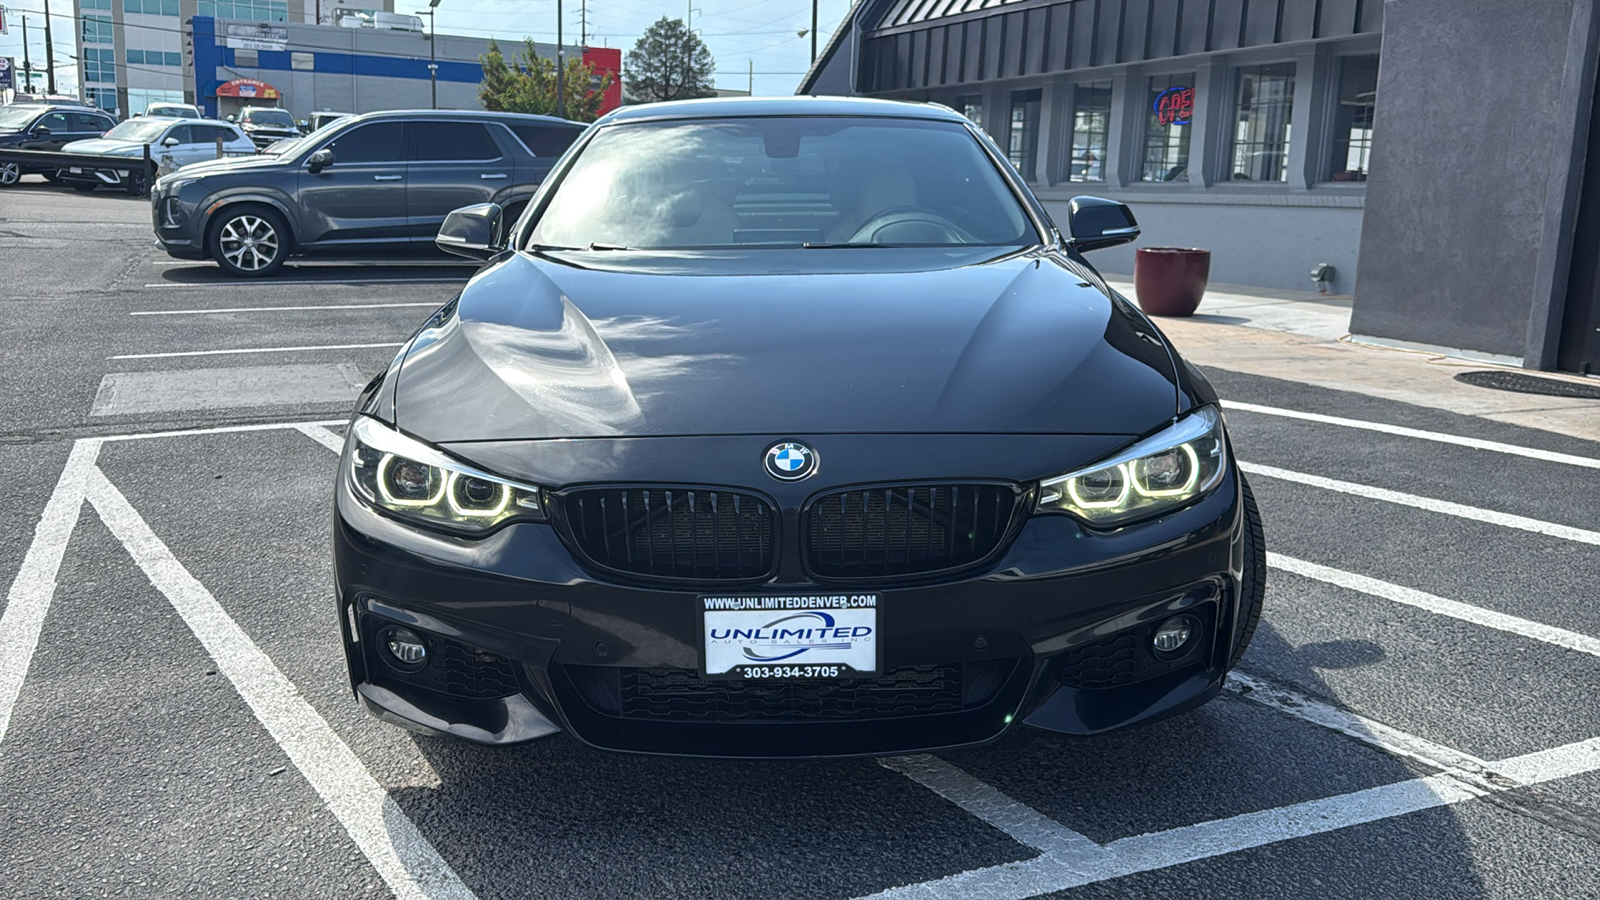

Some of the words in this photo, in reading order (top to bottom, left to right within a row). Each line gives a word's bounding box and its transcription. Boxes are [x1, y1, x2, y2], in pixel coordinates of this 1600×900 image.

[231, 79, 265, 88] ENTRANCE
[1158, 88, 1195, 126] OPE
[770, 443, 811, 455] BMW
[704, 595, 877, 610] WWWUNLIMITEDDENVER.COM
[710, 626, 873, 640] UNLIMITED
[743, 666, 839, 679] 303-934-3705
